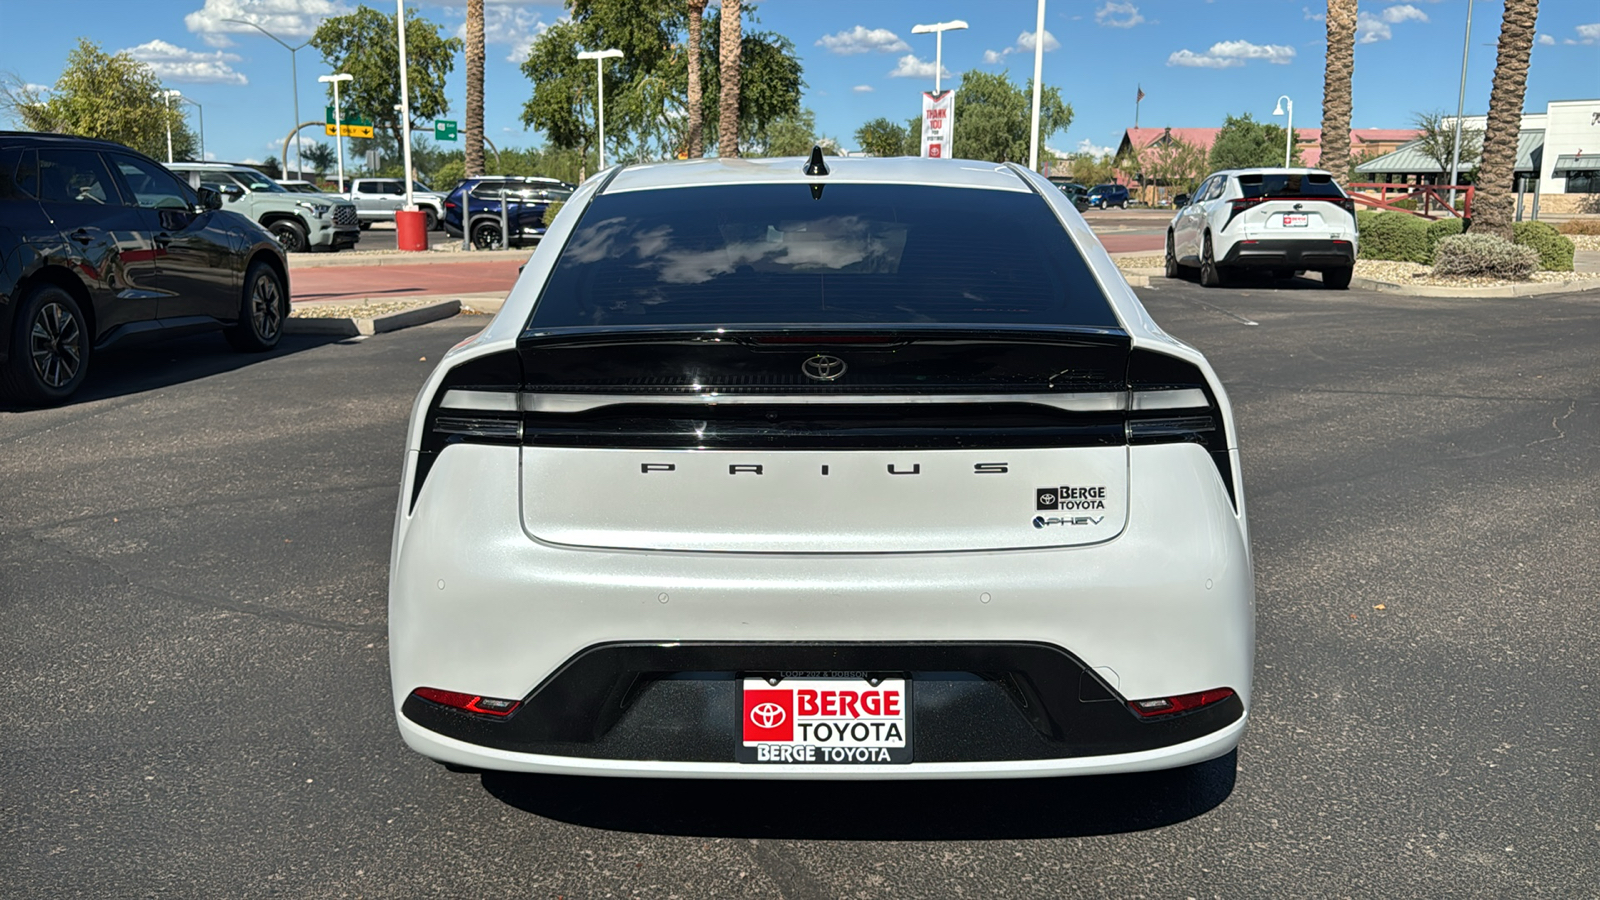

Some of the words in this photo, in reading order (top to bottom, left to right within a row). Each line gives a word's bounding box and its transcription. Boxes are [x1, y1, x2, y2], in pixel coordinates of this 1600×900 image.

[926, 109, 946, 119] THANK
[930, 120, 942, 129] YOU
[641, 462, 1008, 476] PRIUS
[1060, 486, 1105, 499] BERGE
[1059, 500, 1105, 510] TOYOTA
[1045, 516, 1105, 526] PHEV
[797, 689, 901, 720] BERGE
[798, 722, 903, 742] TOYOTA
[757, 744, 816, 763] BERGE
[821, 747, 891, 762] TOYOTA
